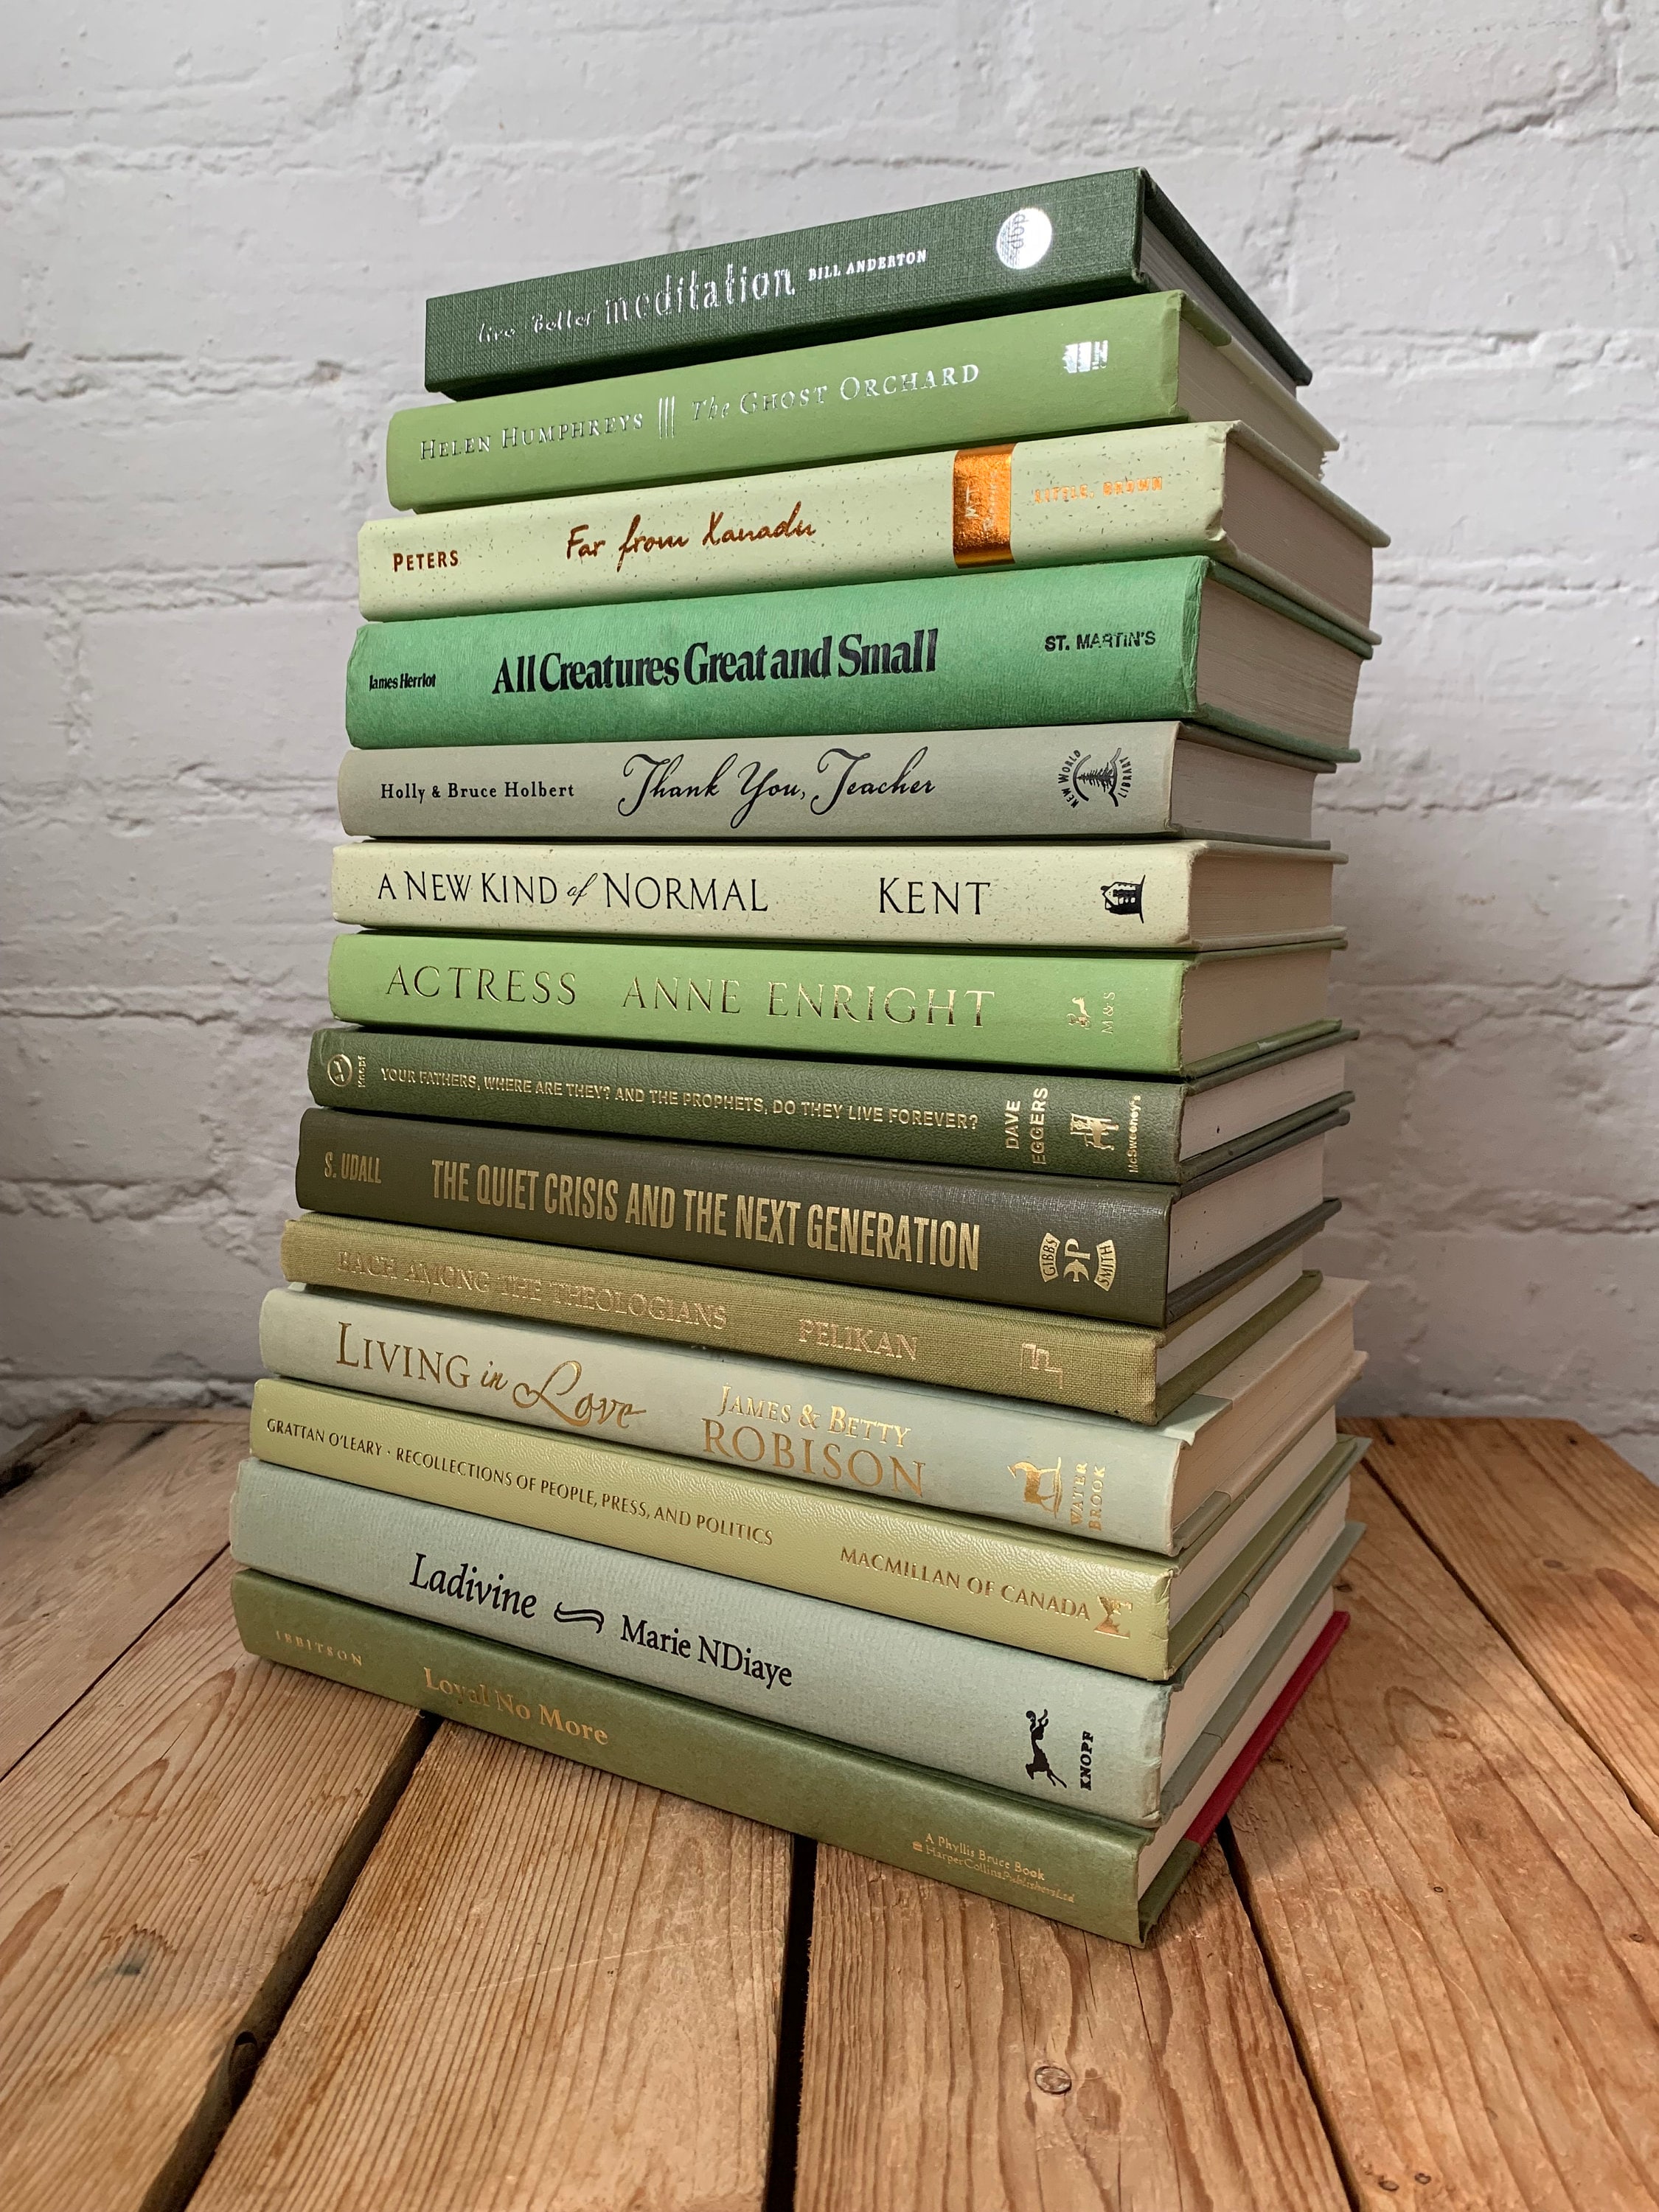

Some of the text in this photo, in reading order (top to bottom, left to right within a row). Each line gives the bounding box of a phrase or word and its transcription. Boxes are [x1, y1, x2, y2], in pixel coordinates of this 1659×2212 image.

[605, 262, 795, 325] meditation
[808, 250, 928, 282] BILL ANDERTON
[692, 364, 980, 421] The GHOST ORCHARD
[420, 413, 643, 461] HELEN HUMPHREYS
[1034, 476, 1163, 504] LITTLE, BROWN
[393, 549, 459, 572] PETERS
[566, 501, 816, 572] Far from Xanadu
[491, 627, 939, 695] All Creatures Great and Small
[1044, 630, 1156, 652] ST. MARTIN'S
[369, 672, 437, 691] James Herriot
[380, 781, 575, 804] Holly & Bruce Holbert
[617, 746, 936, 830] Thank You, Teacher
[1057, 749, 1081, 809] NEW WORLD
[1117, 757, 1133, 799] LIBRARY
[378, 871, 768, 911] A NEW KIND of NORMAL
[879, 877, 991, 915] KENT
[385, 964, 577, 1006] ACTRESS
[621, 975, 995, 1028] ANNE ENRIGHT
[380, 1068, 978, 1130] YOUR FATHERS, WHERE ARE THEY? AND THE PROPHETS, DO THEY LIVE FOREVER?
[1005, 1099, 1020, 1150] DAVE
[1029, 1088, 1048, 1165] EGGERS
[1127, 1094, 1141, 1173] McSweeney's
[324, 1151, 382, 1183] S. UDALL
[431, 1159, 980, 1271] THE QUIET CRISIS AND THE NEXT GENERATION
[1041, 1238, 1058, 1276] GIBBS
[1096, 1245, 1114, 1287] SMITH
[404, 1260, 490, 1293] AMONG
[496, 1274, 542, 1301] THE
[549, 1280, 727, 1330] THEOLOGIANS
[799, 1318, 919, 1361] PELIKAN
[336, 1321, 647, 1429] LIVING in Love
[716, 1383, 911, 1447] JAMES & BETTY
[267, 1418, 773, 1546] GRATTAN O'LEARY RECOLLECTIONS OF PEOPLE, PRESS, AND POLITICS
[701, 1418, 926, 1498] ROBISON
[1070, 1462, 1088, 1526] WATER
[1088, 1465, 1106, 1531] BROOK
[409, 1552, 537, 1618] Ladivine
[840, 1546, 1091, 1621] MACMILLAN OF CANADA
[620, 1614, 793, 1690] Marie NDiaye
[423, 1666, 609, 1746] Loyal No More
[1079, 1731, 1093, 1791] KNOPF
[925, 1833, 1046, 1881] A Phyllis Bruce Book
